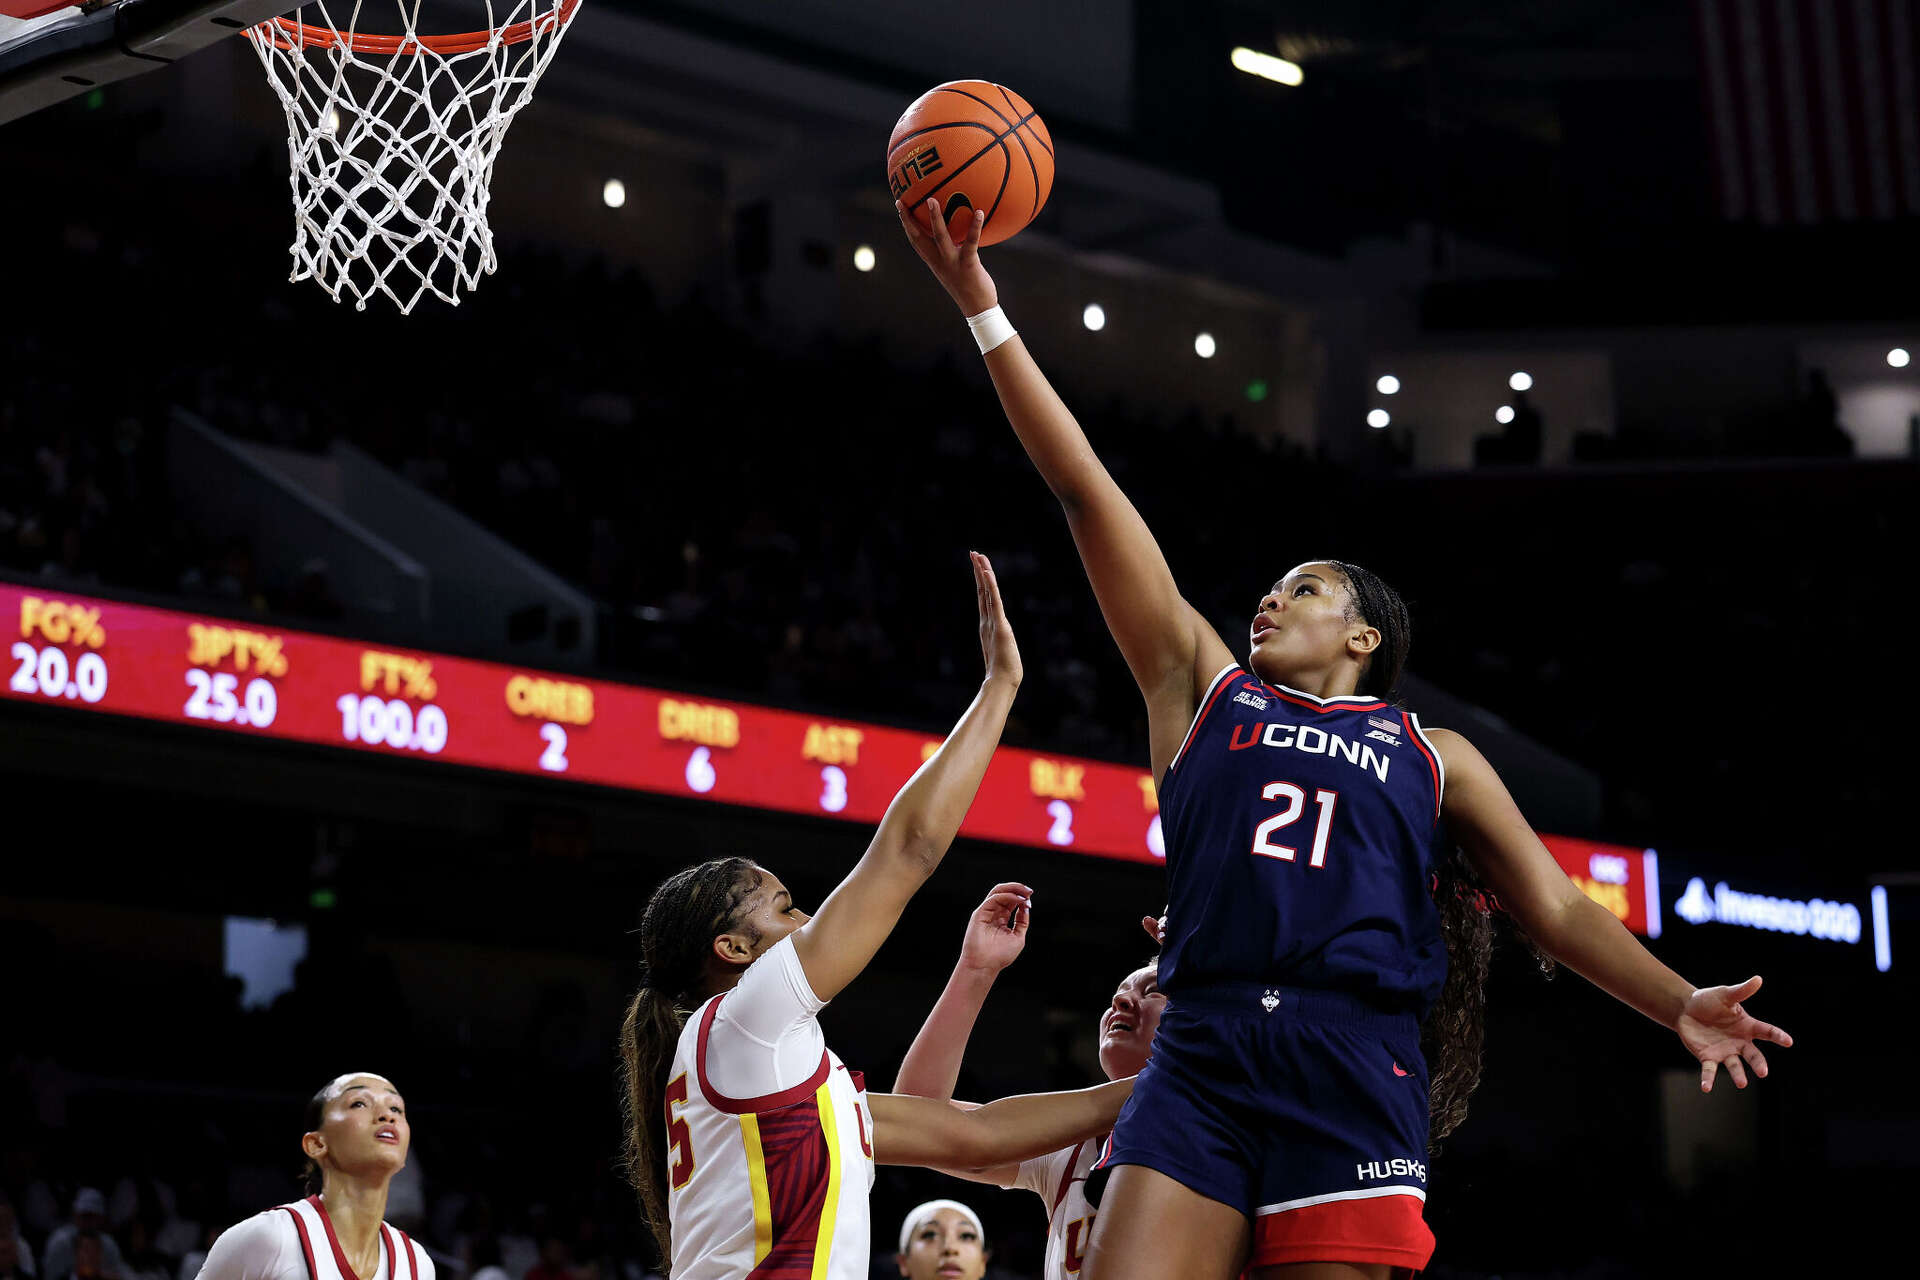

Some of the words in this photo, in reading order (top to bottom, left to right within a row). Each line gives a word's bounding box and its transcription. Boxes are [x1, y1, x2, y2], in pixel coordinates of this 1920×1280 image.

[890, 146, 944, 200] ELITE
[20, 596, 105, 648] FG%
[10, 642, 108, 703] 20.0
[188, 623, 288, 677] 3PT%
[184, 668, 277, 728] 25.0
[360, 651, 437, 700] FT%
[506, 675, 594, 725] OREB
[337, 694, 448, 753] 100.0
[658, 699, 740, 748] DREB
[1233, 696, 1267, 710] CHANGE
[540, 723, 568, 772] 2
[802, 723, 863, 766] AST
[1229, 722, 1390, 783] UCONN
[686, 747, 716, 793] 6
[820, 766, 848, 812] 3
[1030, 759, 1085, 800] BLK
[1048, 801, 1074, 846] 2
[1251, 780, 1338, 869] 21
